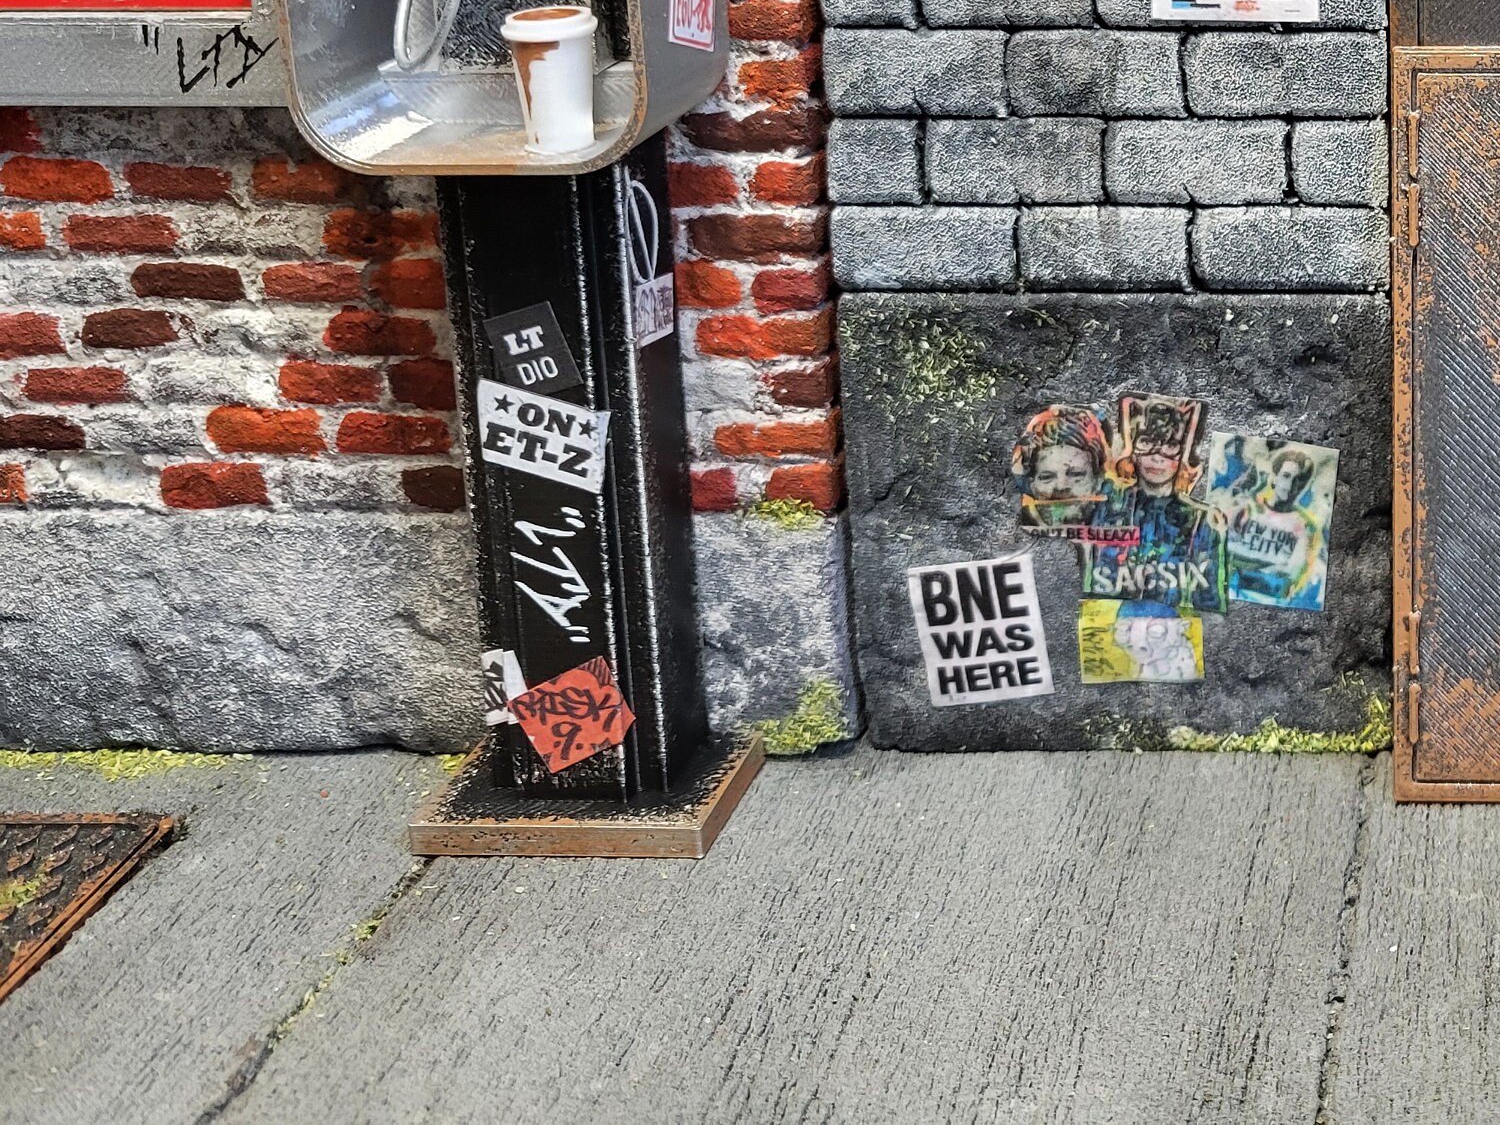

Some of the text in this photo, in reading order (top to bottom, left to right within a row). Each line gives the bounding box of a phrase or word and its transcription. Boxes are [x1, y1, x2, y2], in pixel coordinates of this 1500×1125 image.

[503, 325, 545, 356] LT
[516, 355, 559, 386] DIO
[517, 403, 577, 438] ON
[483, 421, 593, 479] ET-Z
[1066, 527, 1084, 540] BE
[919, 562, 1031, 627] BNE
[930, 623, 1035, 660] WAS
[937, 656, 1043, 695] HERE
